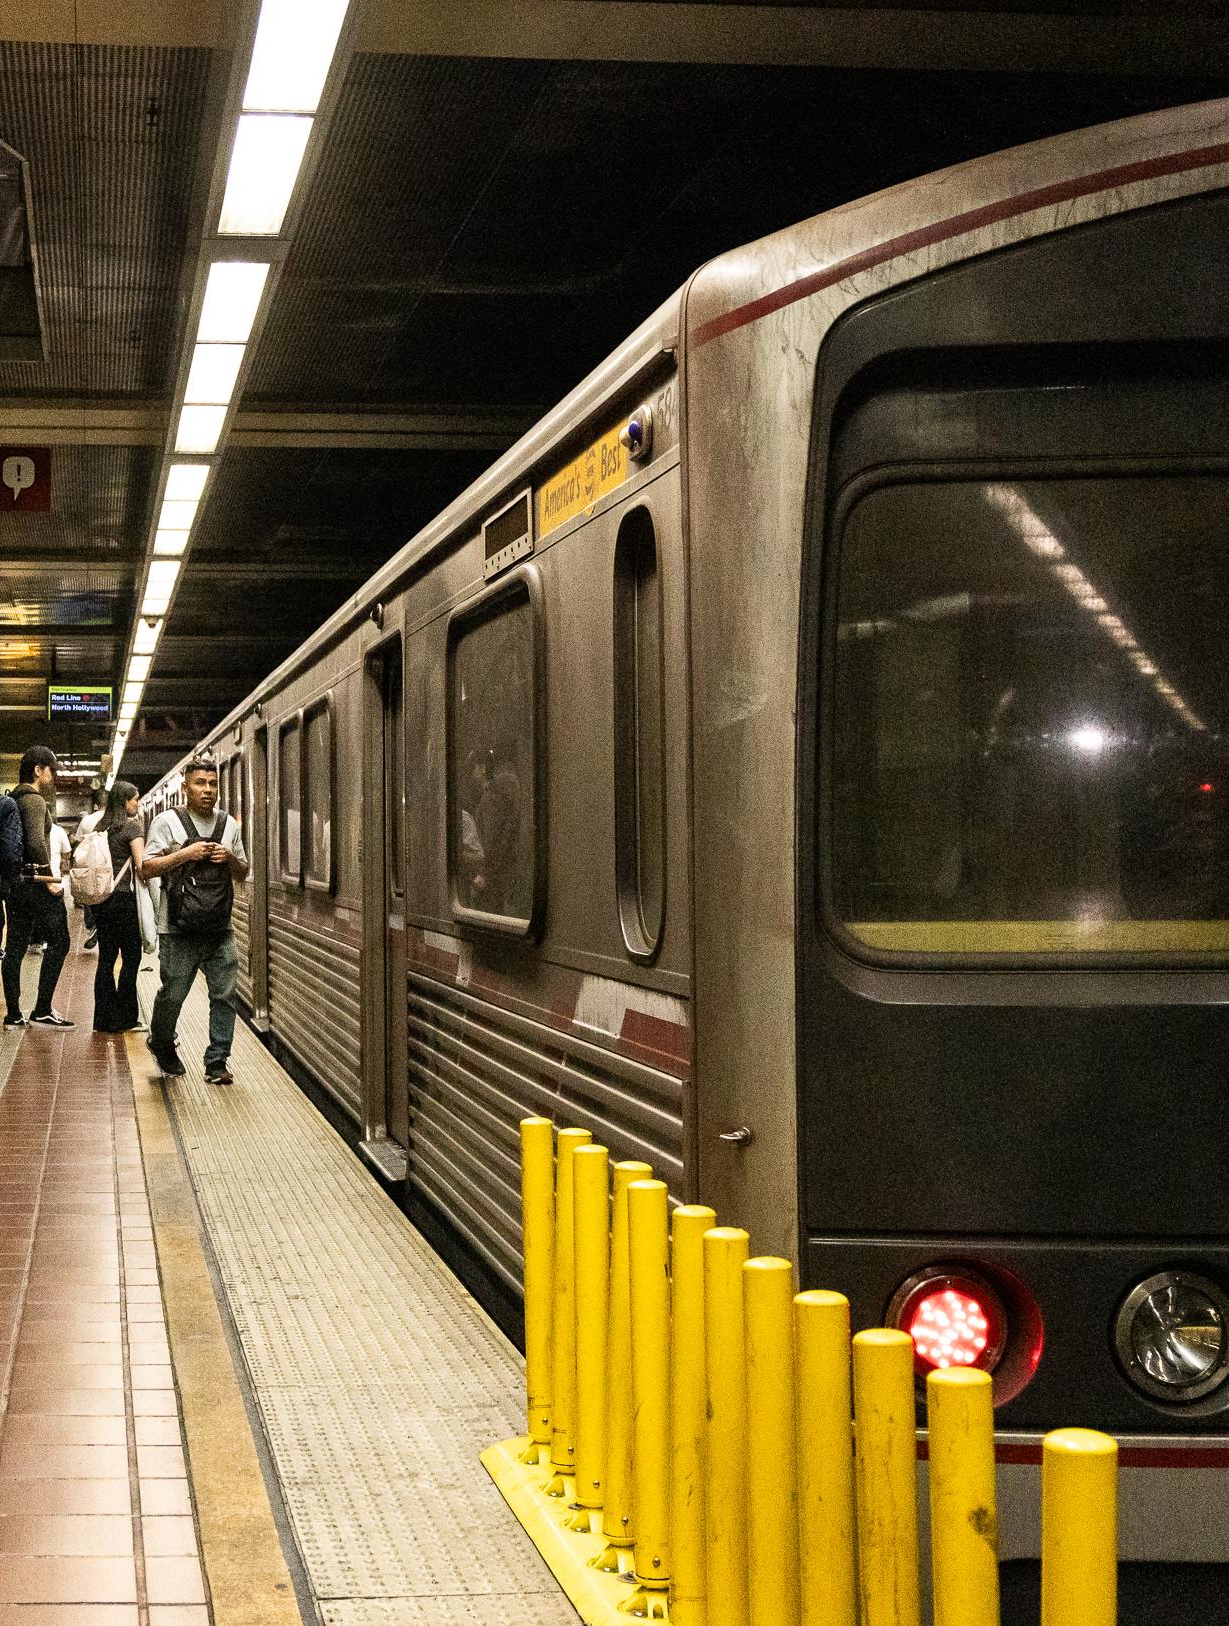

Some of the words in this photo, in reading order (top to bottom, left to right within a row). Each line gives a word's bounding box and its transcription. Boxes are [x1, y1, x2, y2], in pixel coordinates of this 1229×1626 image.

[544, 464, 581, 520] America's
[601, 437, 621, 481] Best
[72, 704, 109, 712] Hollywood
